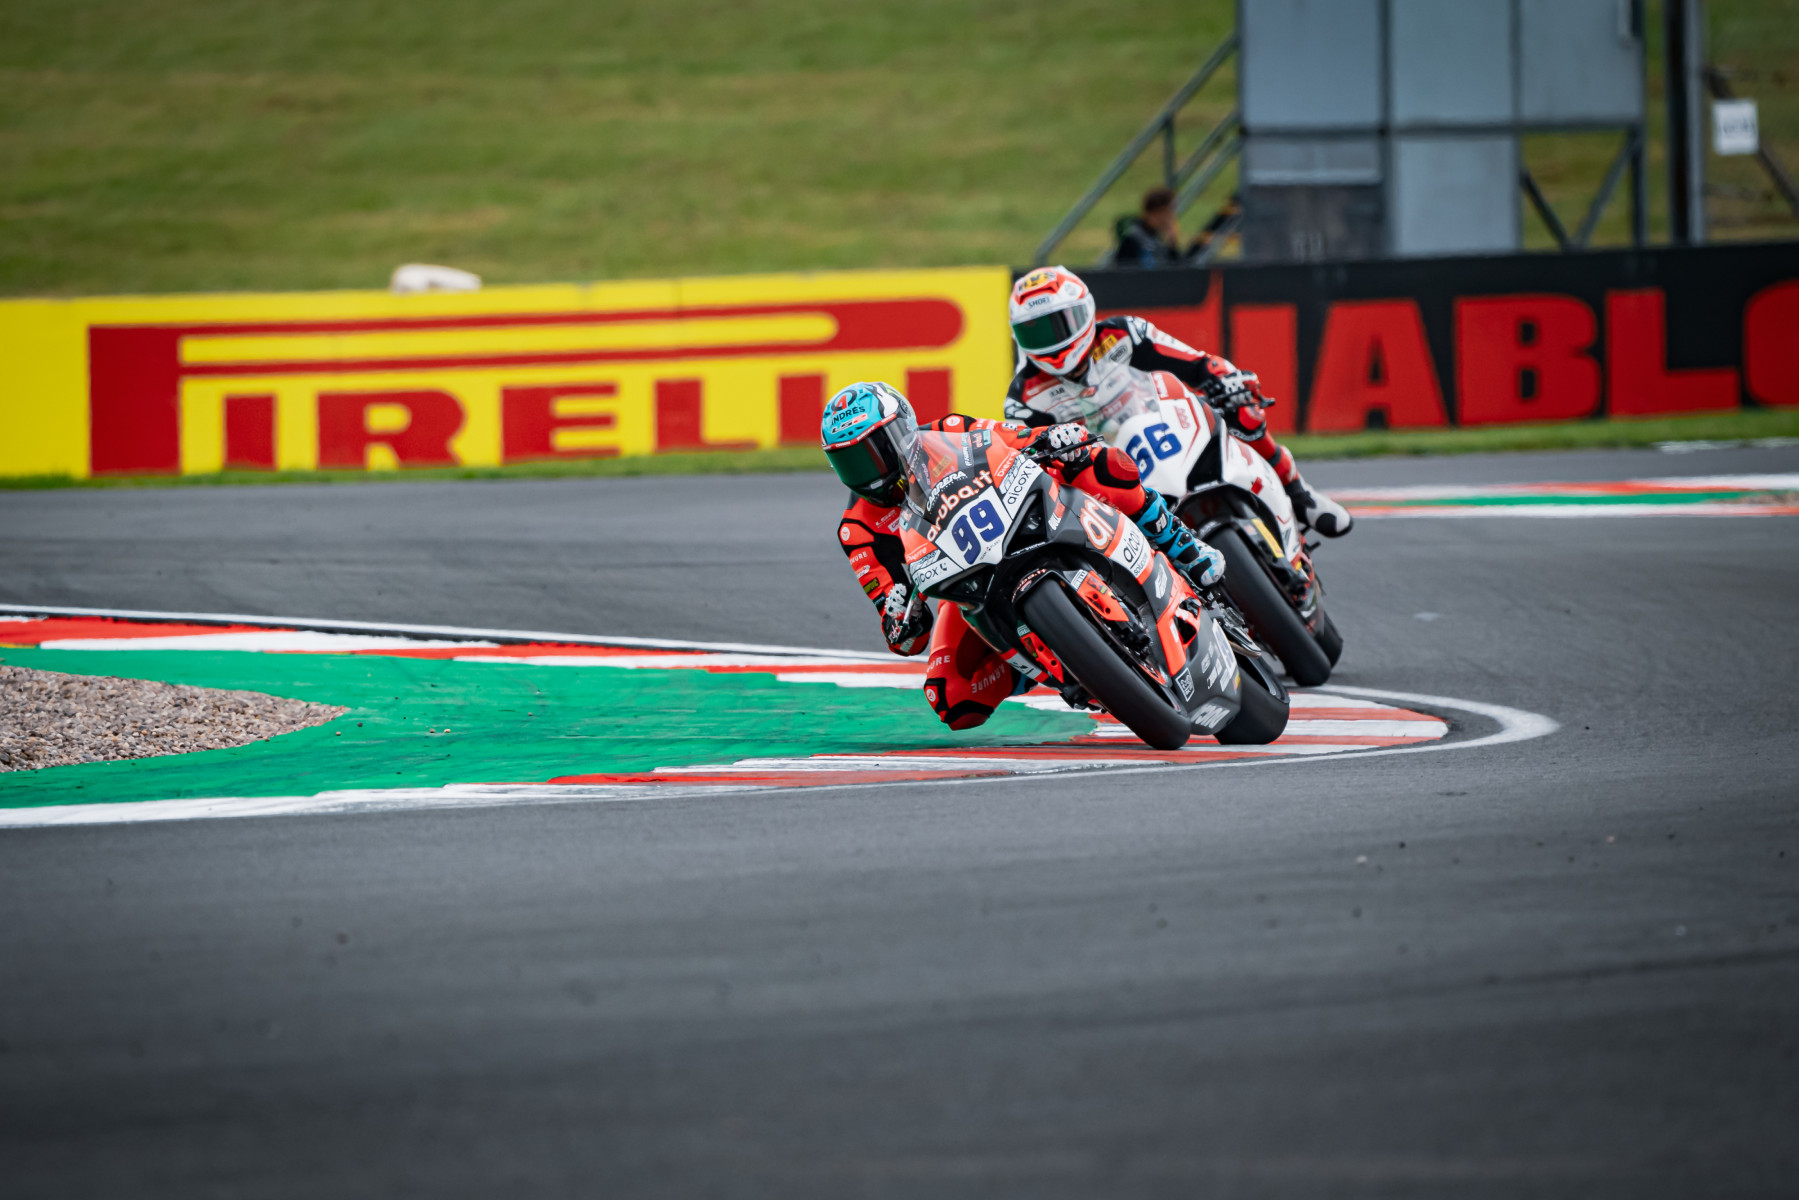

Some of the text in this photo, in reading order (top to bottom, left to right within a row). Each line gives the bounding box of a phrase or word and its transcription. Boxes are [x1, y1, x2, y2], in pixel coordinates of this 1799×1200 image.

[1126, 422, 1182, 482] 66
[926, 471, 968, 511] CARRERA
[927, 469, 994, 542] aruba.it
[1007, 470, 1032, 505] aicox
[951, 499, 1005, 565] 99
